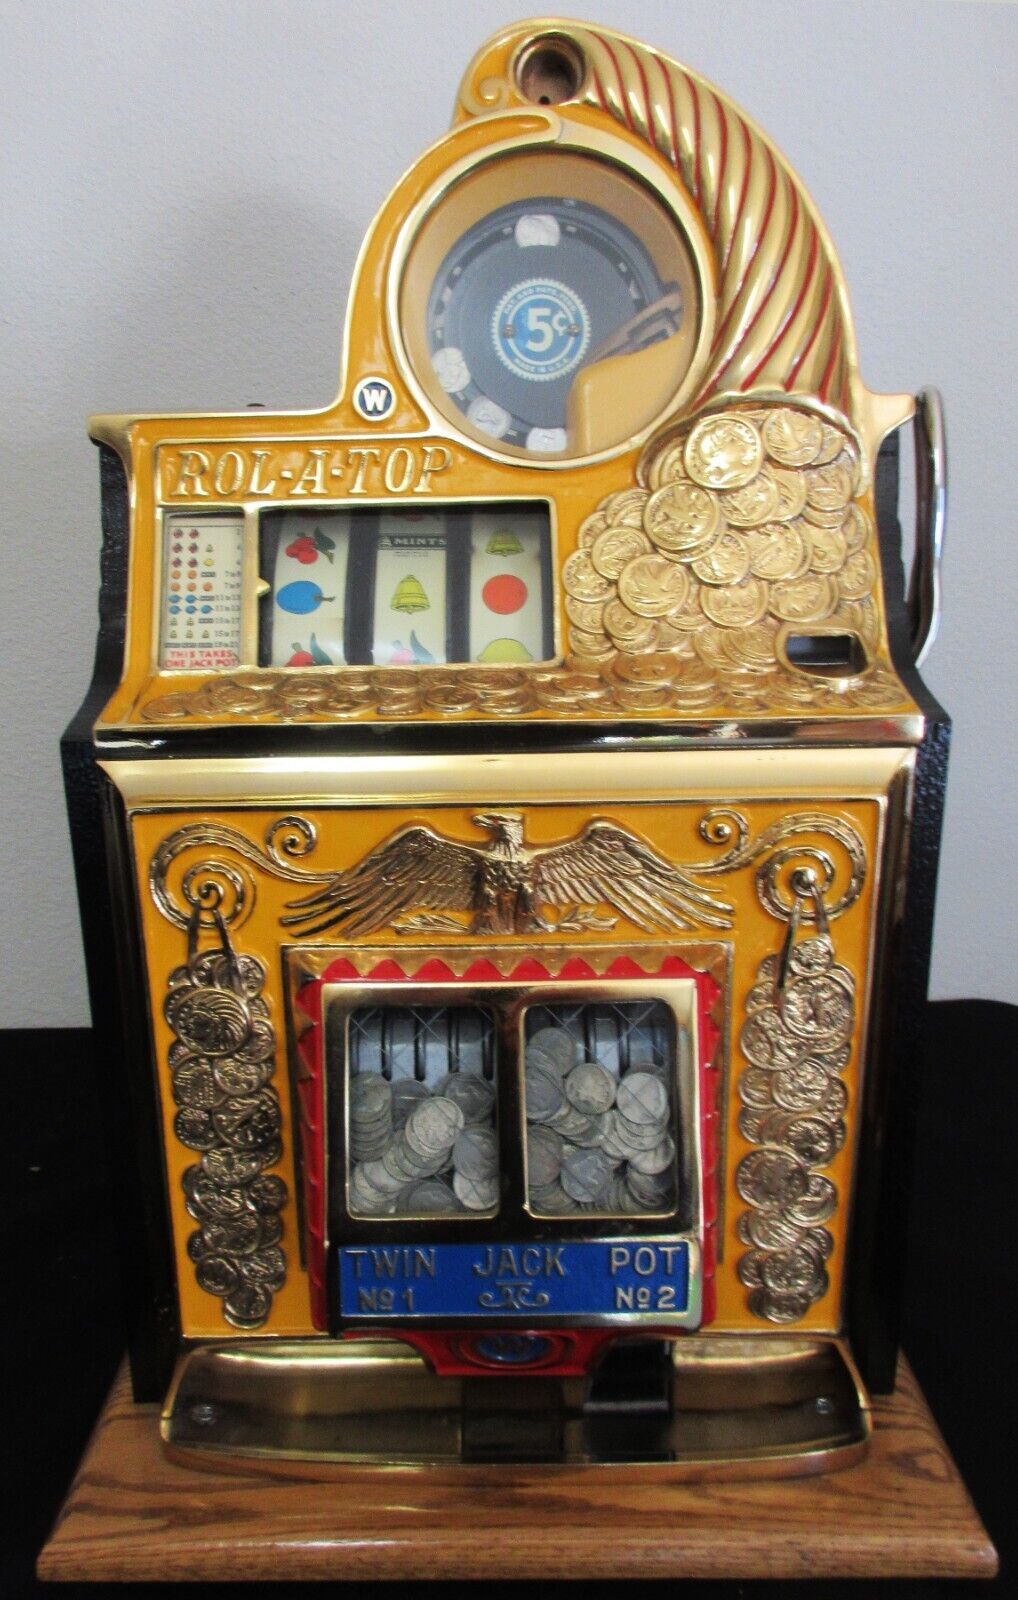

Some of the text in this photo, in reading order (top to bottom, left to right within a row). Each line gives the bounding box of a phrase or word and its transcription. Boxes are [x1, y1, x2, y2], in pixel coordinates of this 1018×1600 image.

[526, 307, 569, 352] 5¢
[362, 387, 388, 412] W
[171, 445, 450, 496] ROL-A-TOP
[393, 537, 447, 546] MINTS
[164, 659, 186, 668] ONE
[189, 659, 213, 667] JACK
[169, 649, 233, 659] THIS TAKES
[346, 1246, 682, 1279] TWIN JACK POT
[402, 1287, 415, 1312] 1
[656, 1285, 676, 1310] 2
